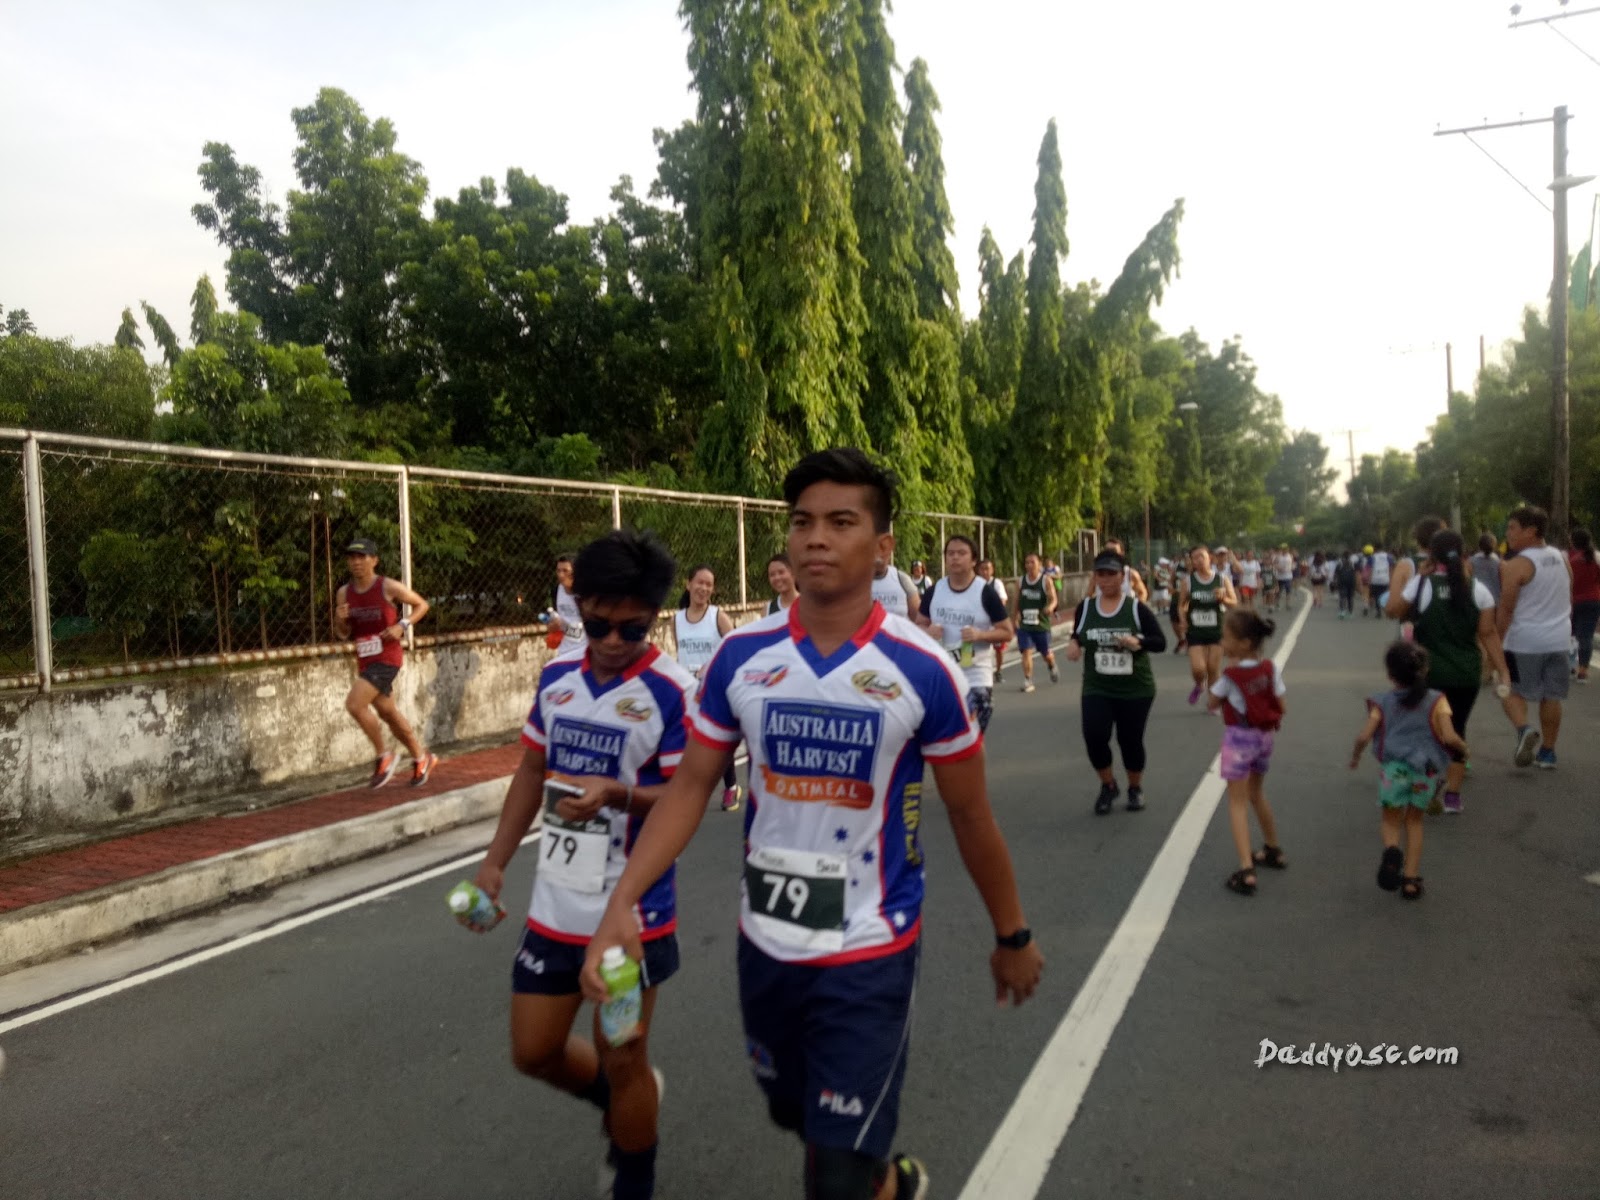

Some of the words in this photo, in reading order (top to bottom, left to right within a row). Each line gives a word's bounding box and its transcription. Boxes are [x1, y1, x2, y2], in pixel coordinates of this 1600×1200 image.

[765, 709, 874, 746] AUSTRALIA
[776, 740, 862, 775] HARVEST
[775, 779, 859, 799] OATMEAL
[547, 831, 577, 865] 79
[763, 872, 809, 919] 79
[819, 1088, 863, 1116] FILA
